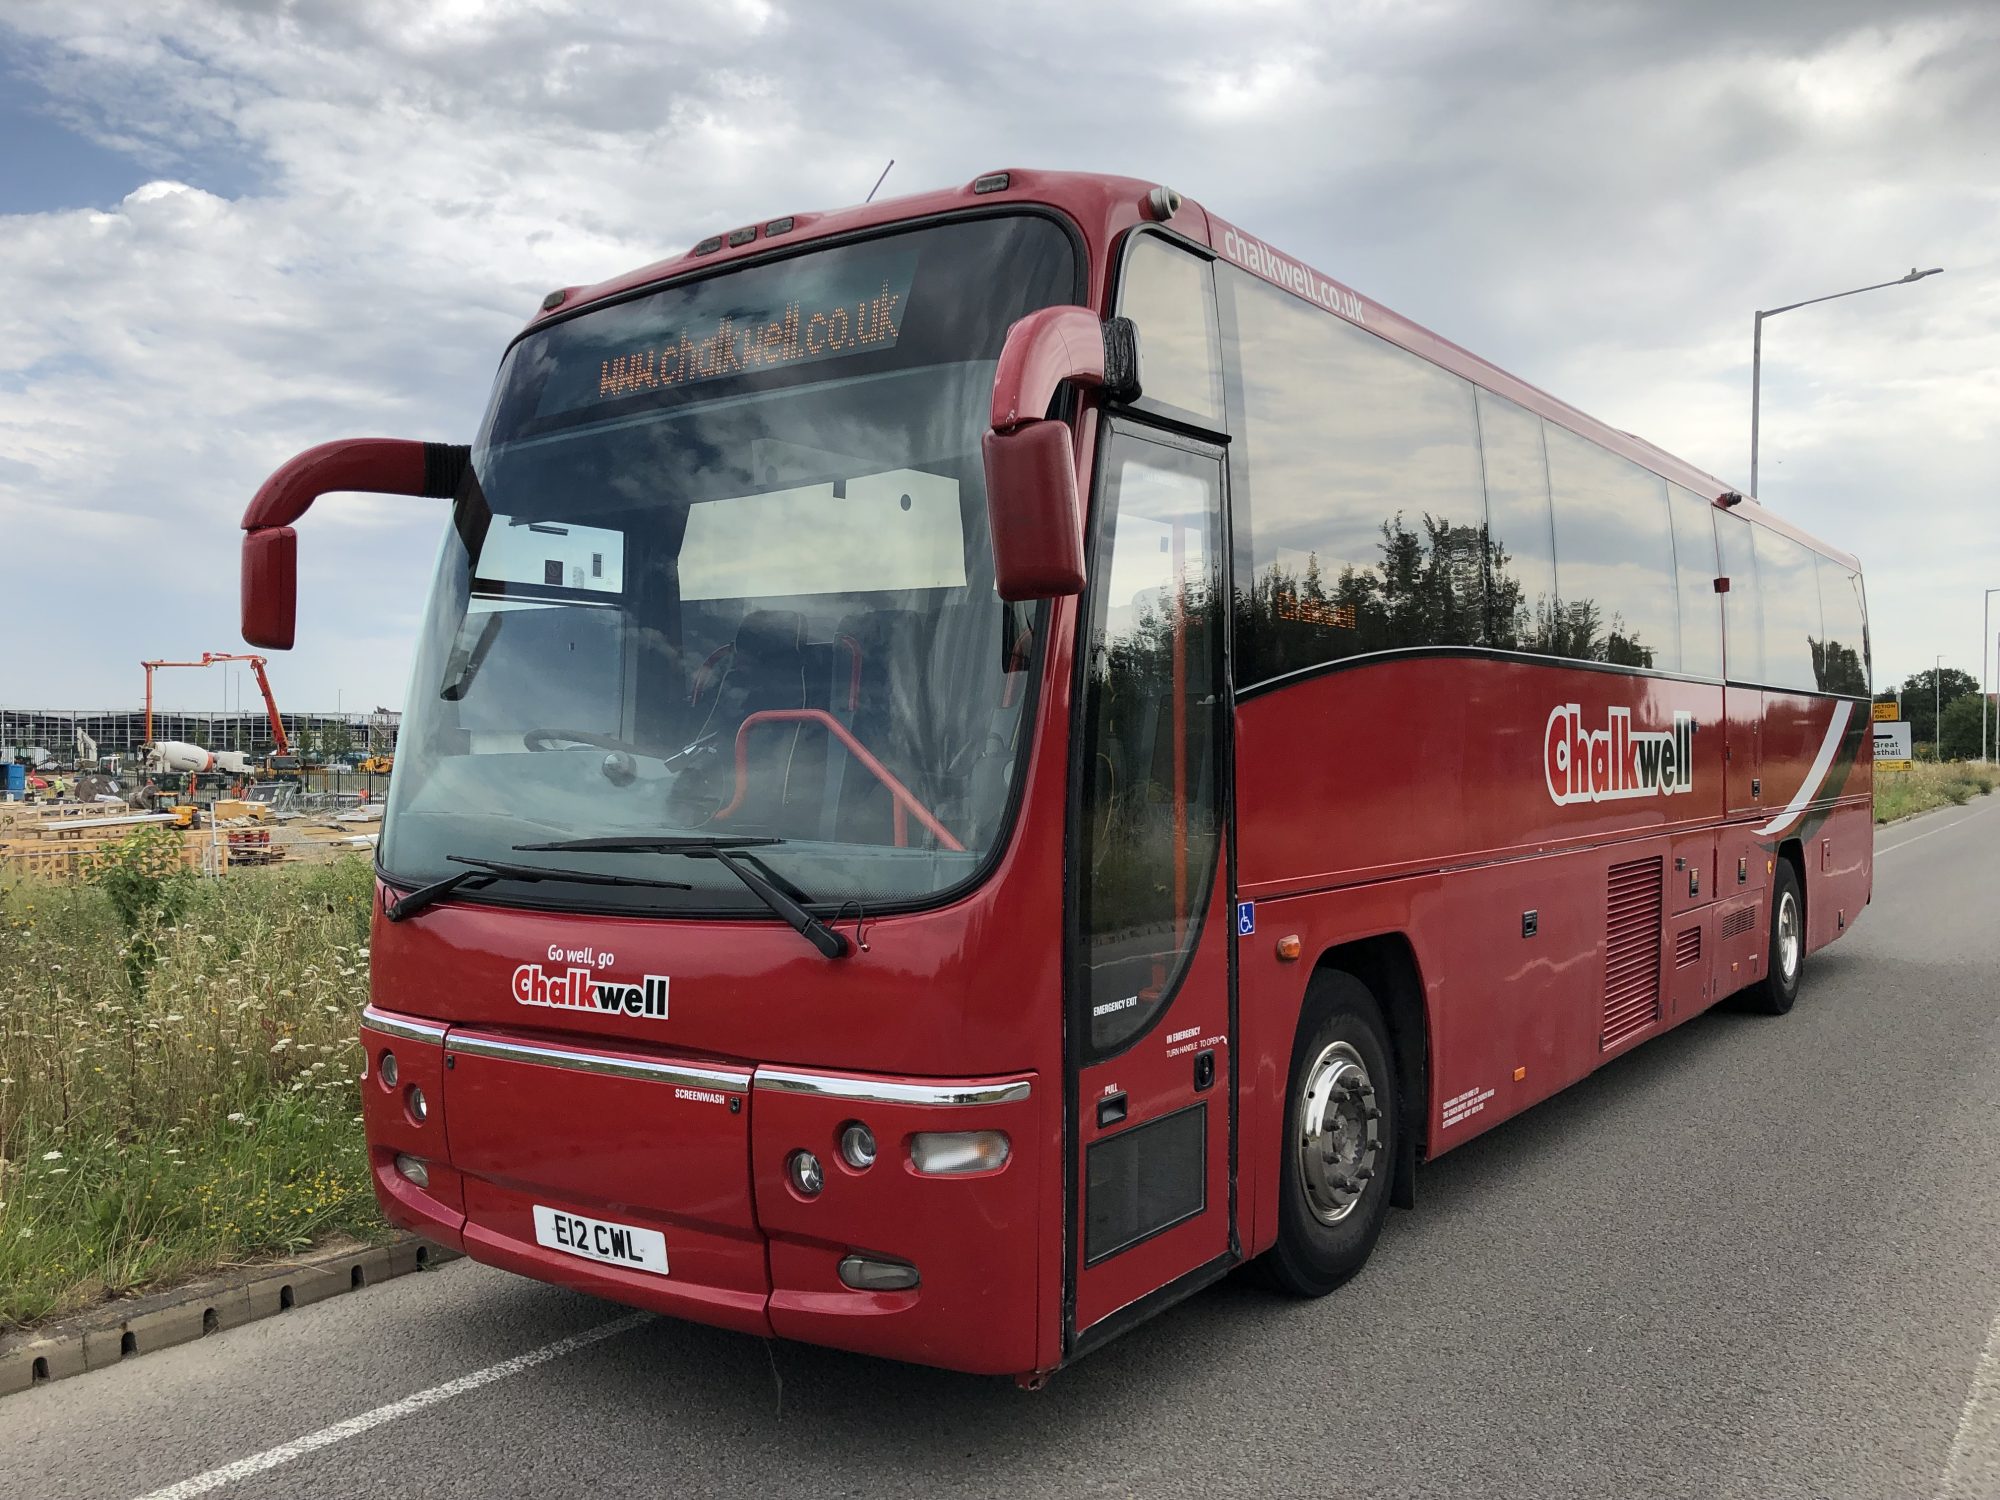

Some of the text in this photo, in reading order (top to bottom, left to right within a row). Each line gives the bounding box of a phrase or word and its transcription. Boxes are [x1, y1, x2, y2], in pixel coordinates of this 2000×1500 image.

[1224, 228, 1366, 324] chalkwell.co.uk
[599, 279, 900, 399] www.chalkwell.co.uk
[1544, 703, 1693, 806] Chalkwell
[547, 944, 615, 970] Go well, go
[512, 964, 670, 1020] Chalkwell
[1093, 995, 1138, 1017] EMERGENCY EXIT
[1166, 1026, 1201, 1045] IN EMERGENCY
[1166, 1036, 1220, 1059] TURN HANDLE TO OPEN
[674, 1088, 725, 1105] SCREENWASH
[1105, 1083, 1118, 1095] PULL
[554, 1213, 644, 1263] E12 CWL
